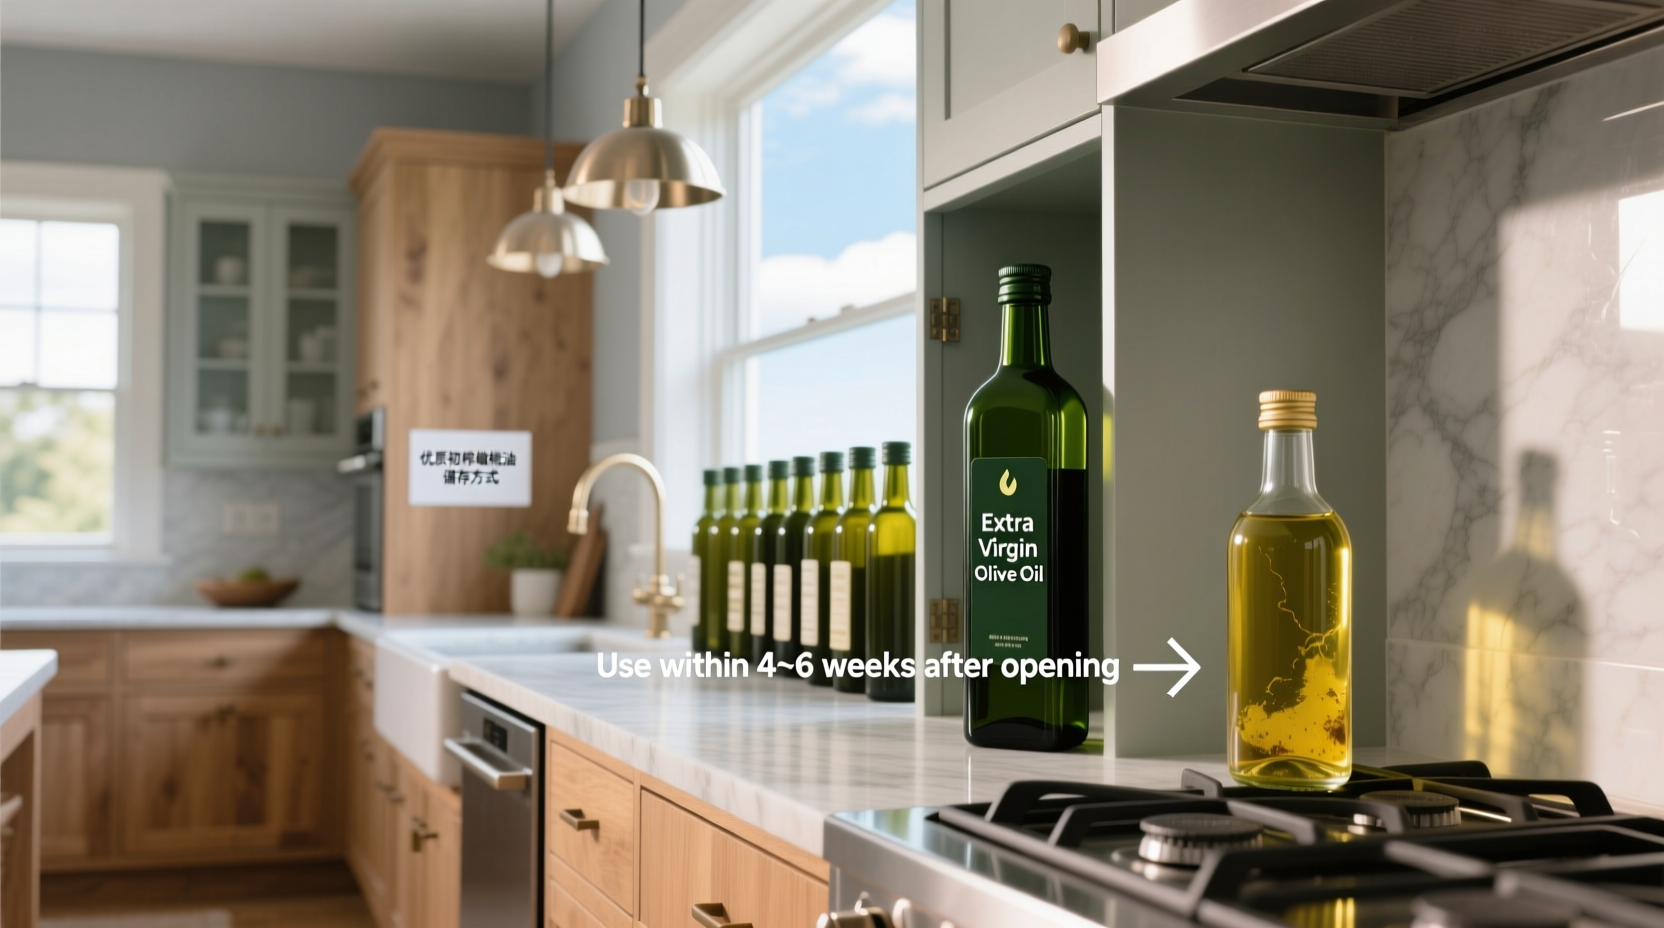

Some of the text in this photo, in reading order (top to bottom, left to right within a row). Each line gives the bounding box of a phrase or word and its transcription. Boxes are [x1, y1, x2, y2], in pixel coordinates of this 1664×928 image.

[981, 513, 1034, 533] Extra
[977, 537, 1038, 563] Virgin
[974, 565, 1044, 582] Olive Oil
